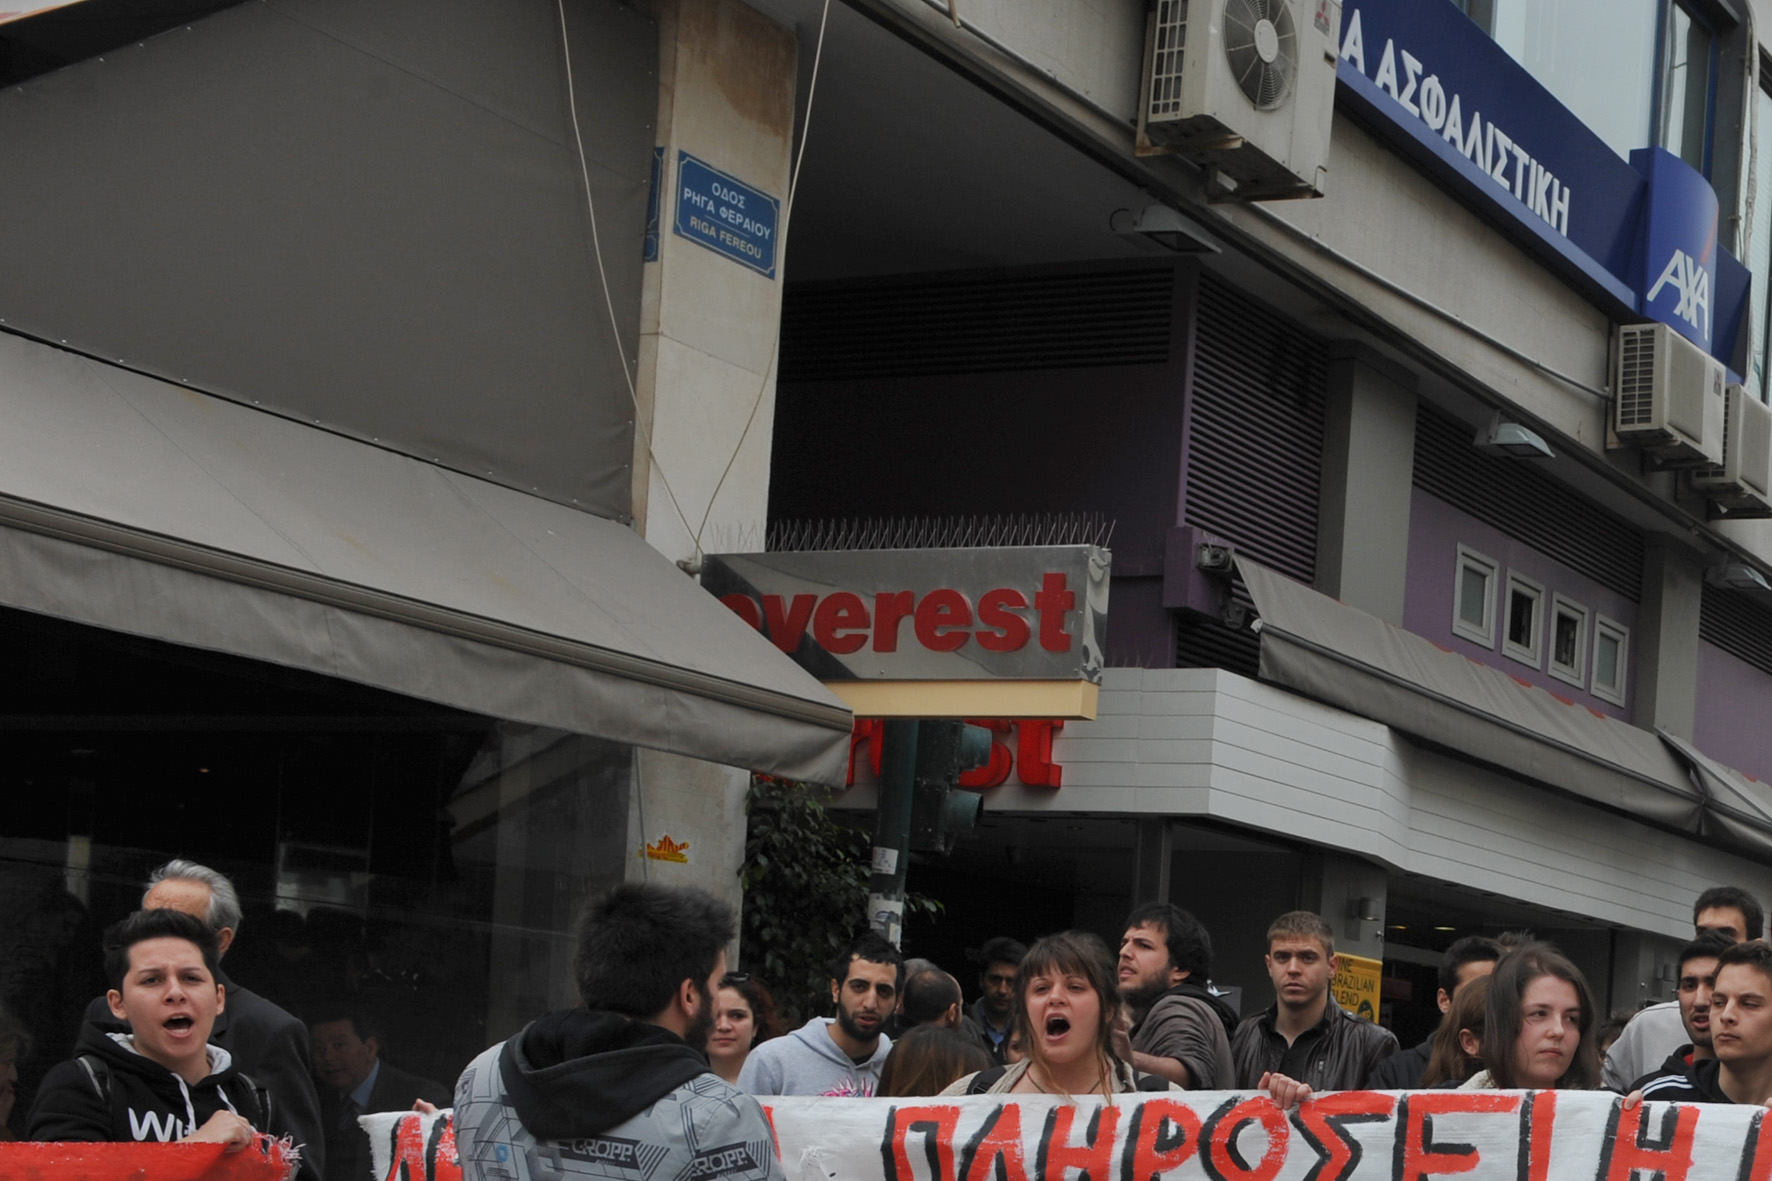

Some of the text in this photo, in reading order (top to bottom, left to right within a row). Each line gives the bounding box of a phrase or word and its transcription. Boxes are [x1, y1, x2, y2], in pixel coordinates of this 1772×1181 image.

[1375, 38, 1570, 239] ΑΣΦΑΛΙΣΤΙΚΗ
[683, 187, 772, 240] ΡΗΓΑ ΦΕΡΑΙΟΥ
[711, 182, 746, 210] ΟΔΟΣ
[689, 215, 762, 260] RIGA FEREOU
[1647, 249, 1710, 342] AXA
